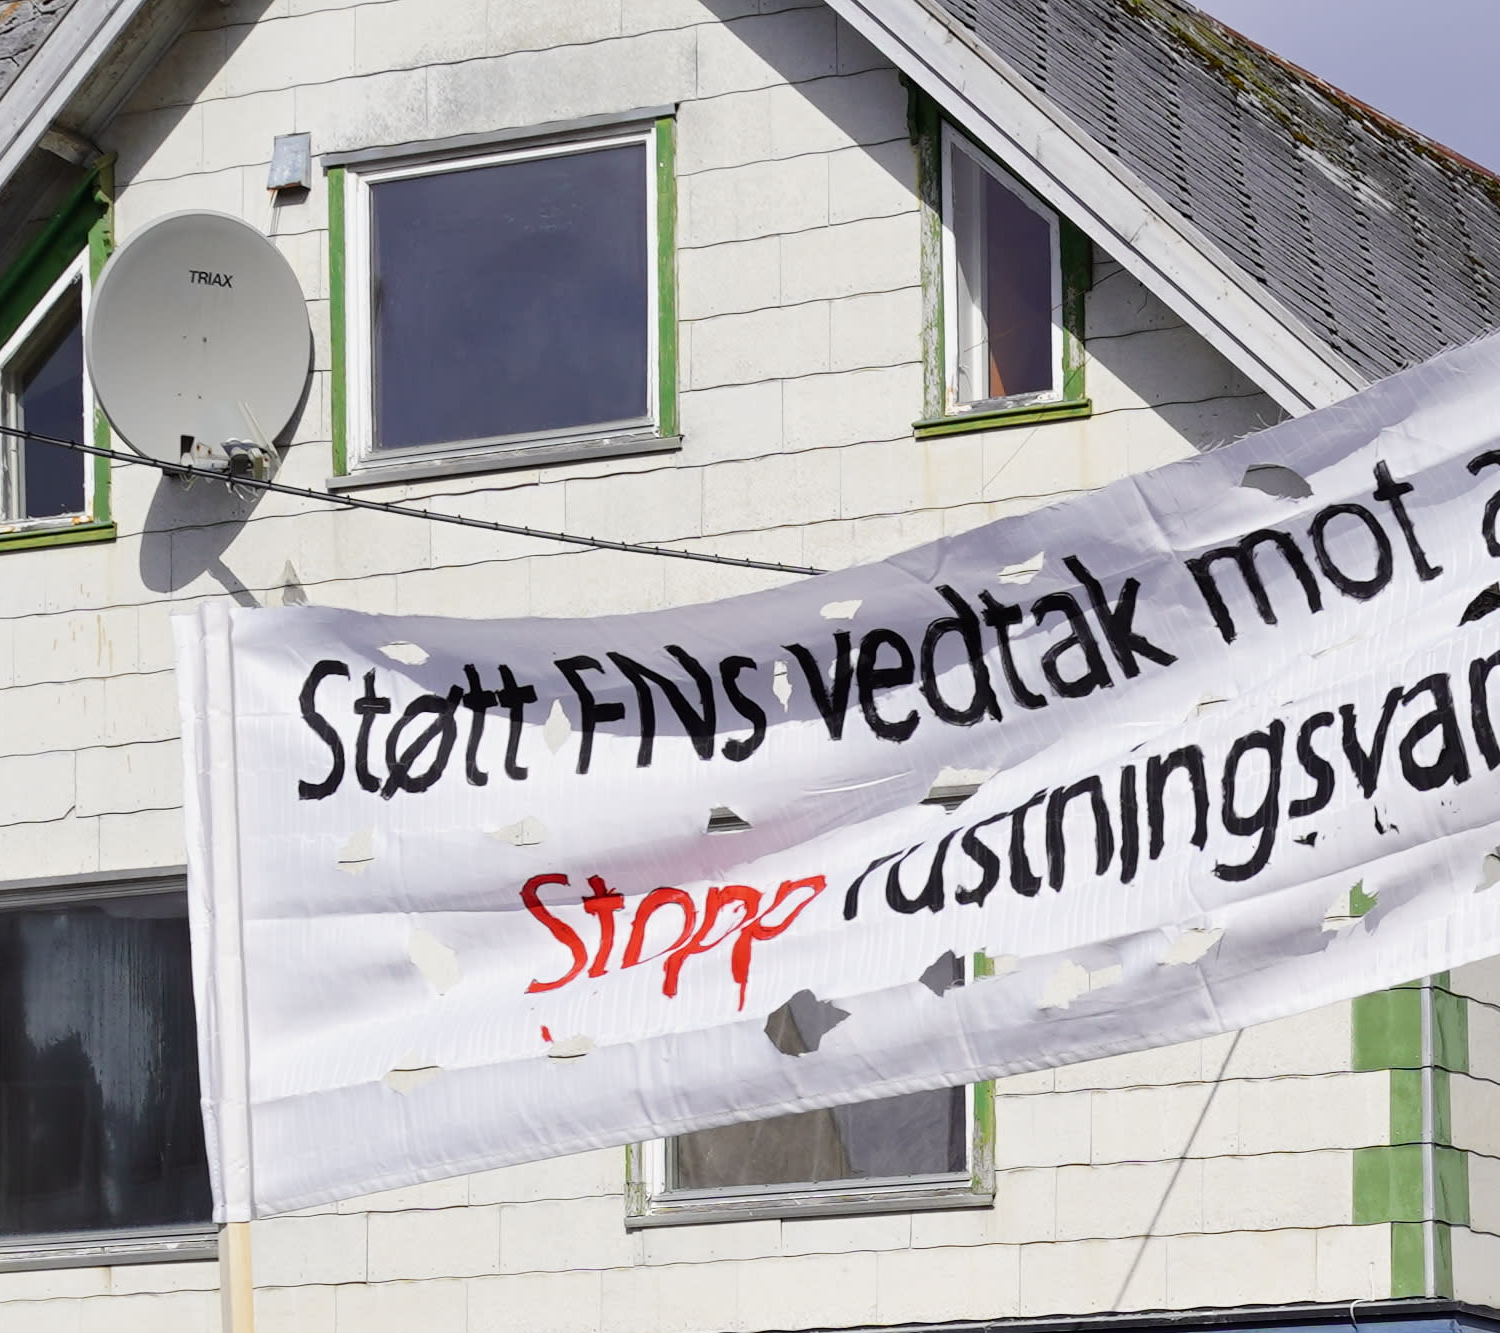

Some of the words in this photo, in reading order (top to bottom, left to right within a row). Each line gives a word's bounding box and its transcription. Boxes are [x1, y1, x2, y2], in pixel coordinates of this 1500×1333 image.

[188, 269, 234, 289] TRIAX
[297, 659, 538, 802] Støtt
[574, 644, 768, 775] FNs
[797, 553, 1176, 744] vedtak
[1186, 462, 1440, 638] mot
[519, 872, 828, 1012] Stopp
